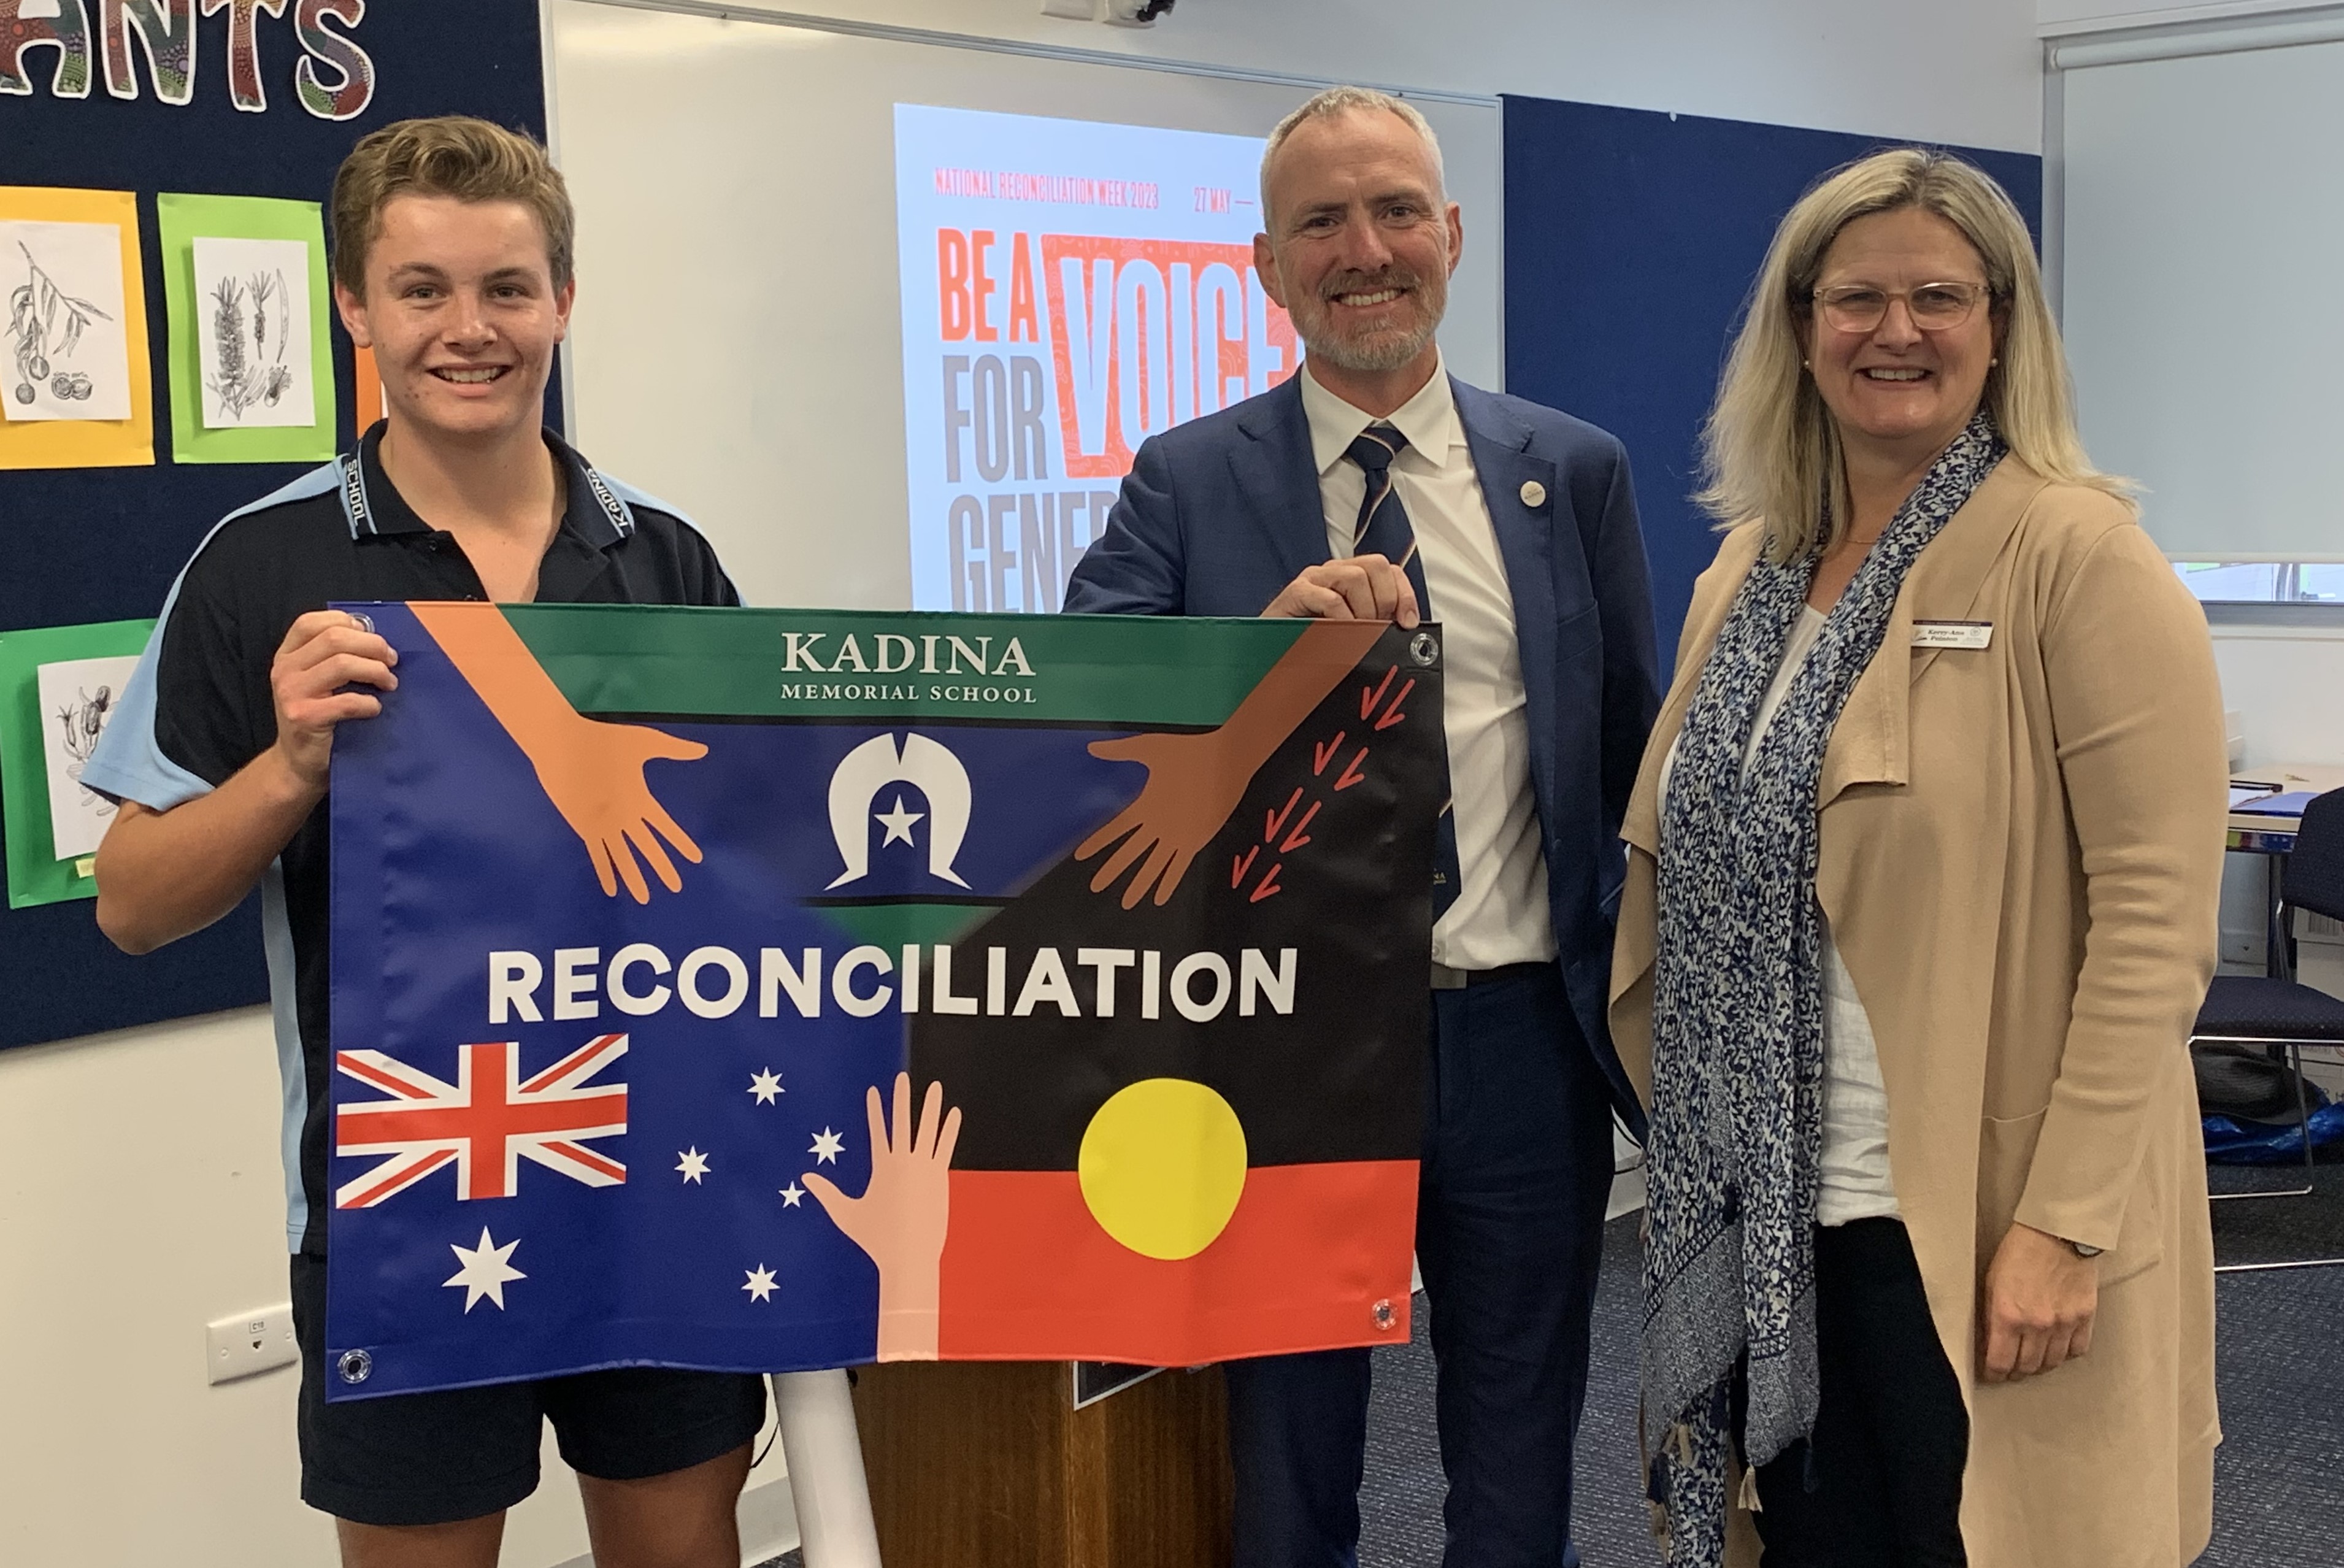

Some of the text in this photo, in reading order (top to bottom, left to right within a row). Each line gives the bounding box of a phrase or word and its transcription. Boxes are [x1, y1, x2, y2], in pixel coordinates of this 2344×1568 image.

[935, 167, 1159, 209] NATIONAL RECONCILIATION WEEK 2023
[1194, 186, 1206, 213] 27
[1210, 187, 1231, 214] MAY
[937, 228, 998, 342] BE
[1009, 232, 1039, 342] A
[942, 354, 1048, 483] FOR
[347, 459, 366, 526] SCHOOL
[587, 468, 628, 527] KADINA
[781, 632, 1037, 676] KADINA
[781, 684, 1037, 704] MEMORIAL SCHOOL
[489, 942, 1298, 1024] RECONCILIATION
